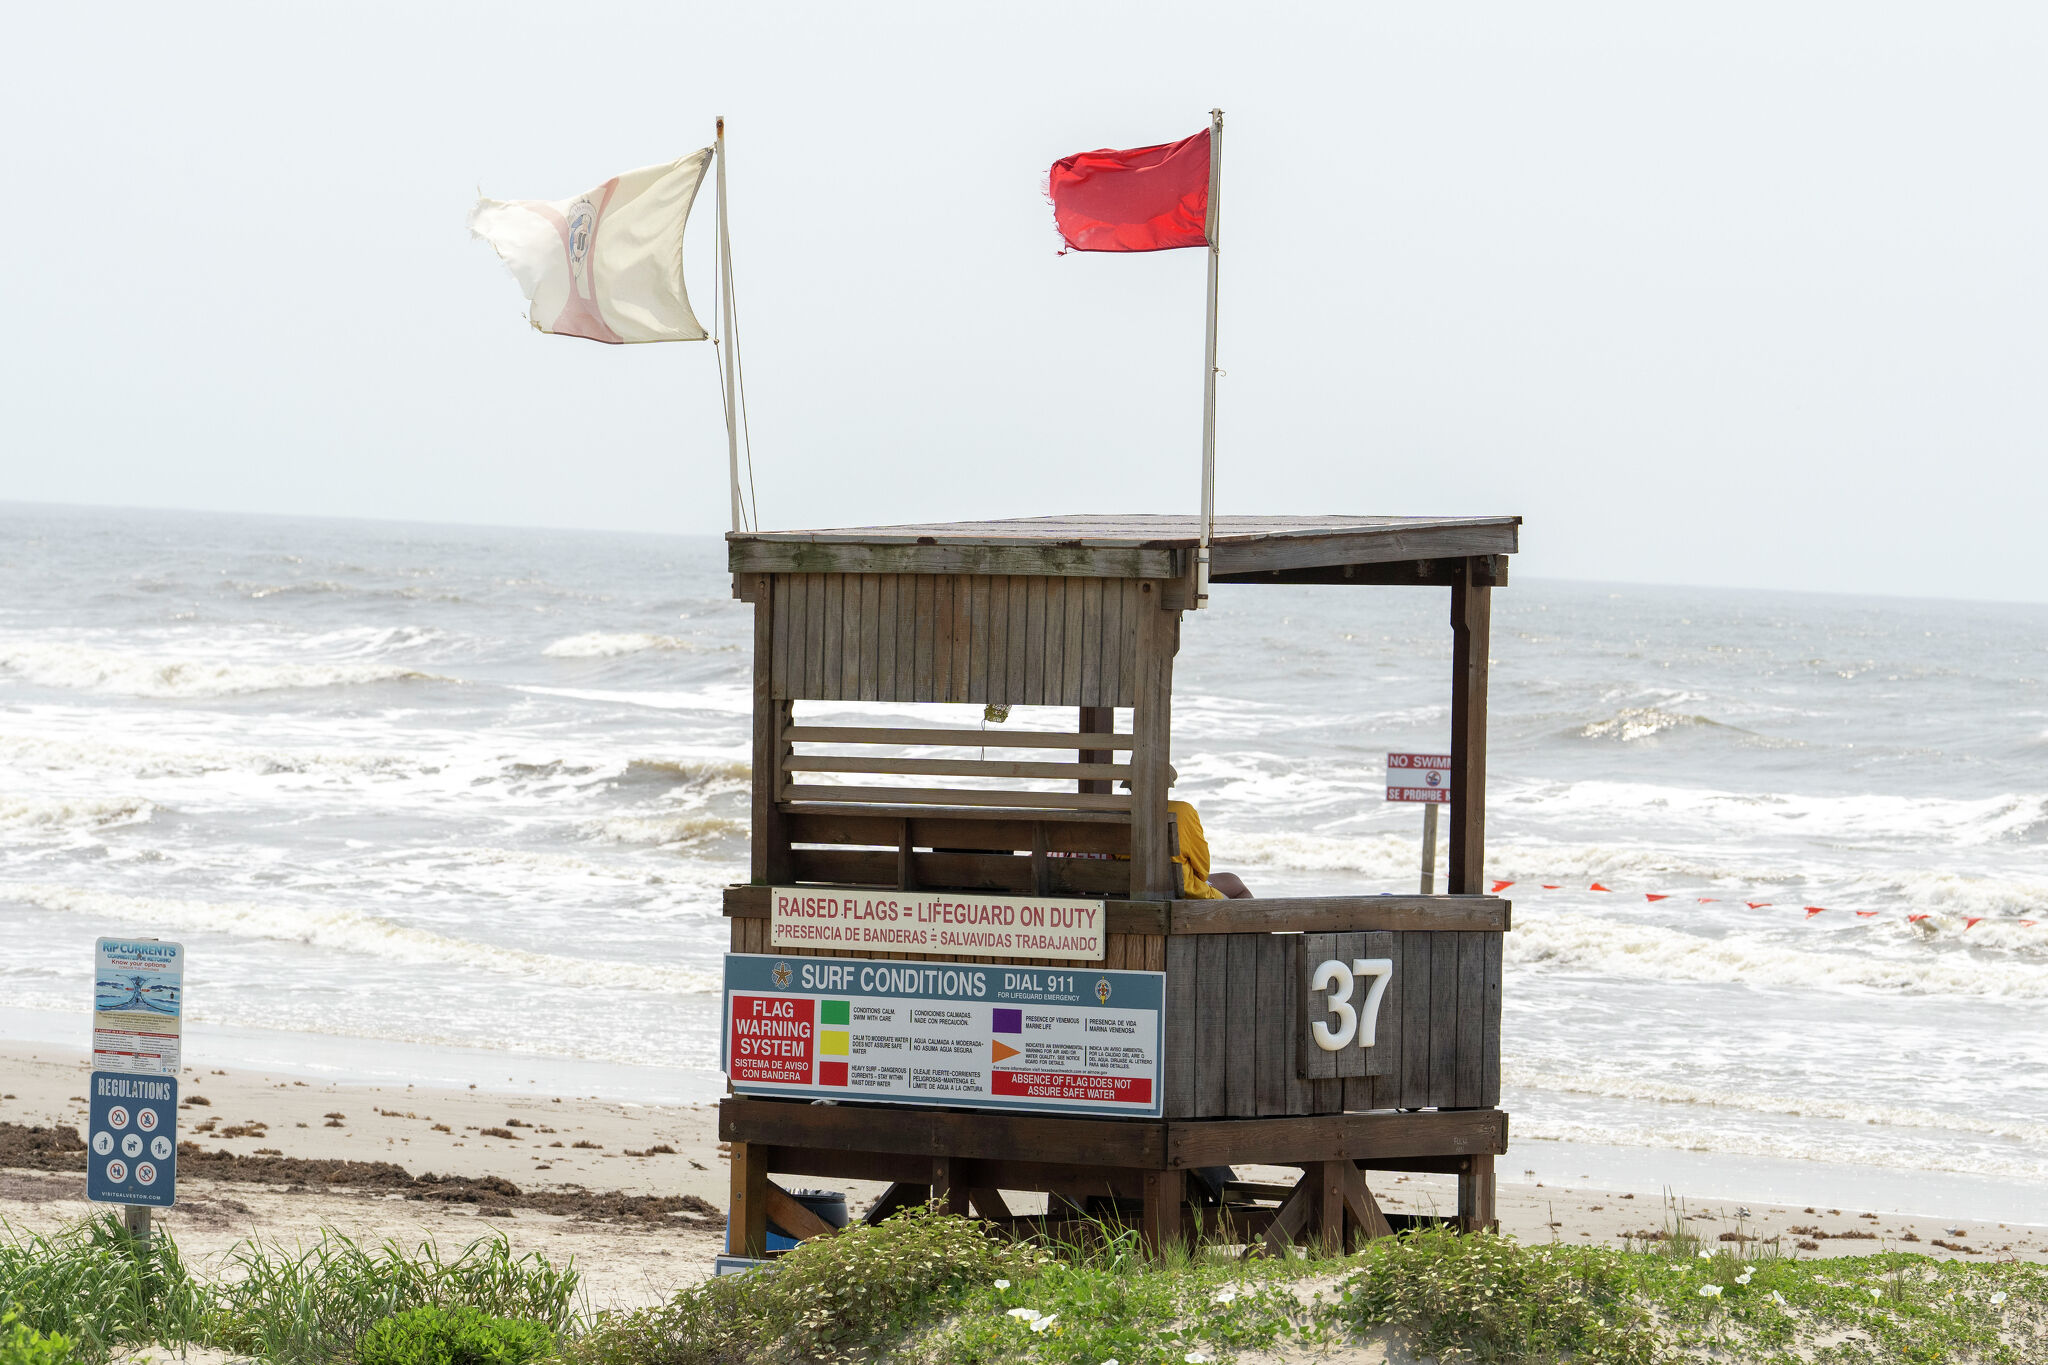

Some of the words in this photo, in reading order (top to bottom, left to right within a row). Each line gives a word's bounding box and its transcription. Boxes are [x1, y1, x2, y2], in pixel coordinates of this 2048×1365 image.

[1390, 756, 1408, 766] NO
[1389, 789, 1400, 799] SE
[1404, 790, 1442, 800] PROHIBE
[778, 897, 838, 918] RAISED
[844, 899, 898, 921] FLAGS
[918, 902, 1015, 926] LIFEGUARD
[1020, 906, 1043, 926] ON
[1050, 907, 1097, 928] DUTY
[777, 926, 842, 940] PRESENCIA
[845, 928, 860, 941] DE
[863, 929, 927, 944] BANDERAS
[940, 933, 1012, 947] SALVAVIDAS
[1015, 935, 1097, 951] TRABAJANDO
[103, 942, 119, 952] RIP
[120, 944, 176, 957] CURRENTS
[802, 965, 854, 991] SURF
[861, 969, 986, 997] CONDITIONS
[1004, 973, 1042, 992] DIAL
[1047, 976, 1074, 993] 911
[1044, 994, 1079, 1002] EMERGENCY
[1312, 958, 1393, 1051] 37
[752, 1001, 794, 1017] FLAG
[737, 1018, 811, 1038] WARNING
[740, 1037, 804, 1057] SYSTEM
[734, 1059, 771, 1069] SISTEMA
[773, 1061, 784, 1069] DE
[786, 1062, 808, 1071] AVISO
[742, 1069, 758, 1078] CON
[760, 1070, 801, 1080] BANDERA
[1012, 1074, 1050, 1084] ABSENCE
[1052, 1075, 1064, 1085] OF
[1066, 1076, 1088, 1086] FLAG
[1090, 1078, 1112, 1087] DOES
[1114, 1079, 1131, 1089] NOT
[98, 1078, 170, 1100] REGULATIONS
[1028, 1086, 1061, 1096] ASSURE
[1063, 1087, 1085, 1097] SAFE
[1087, 1089, 1115, 1099] WATER
[102, 1192, 160, 1200] VISITGALVESTON.COM
